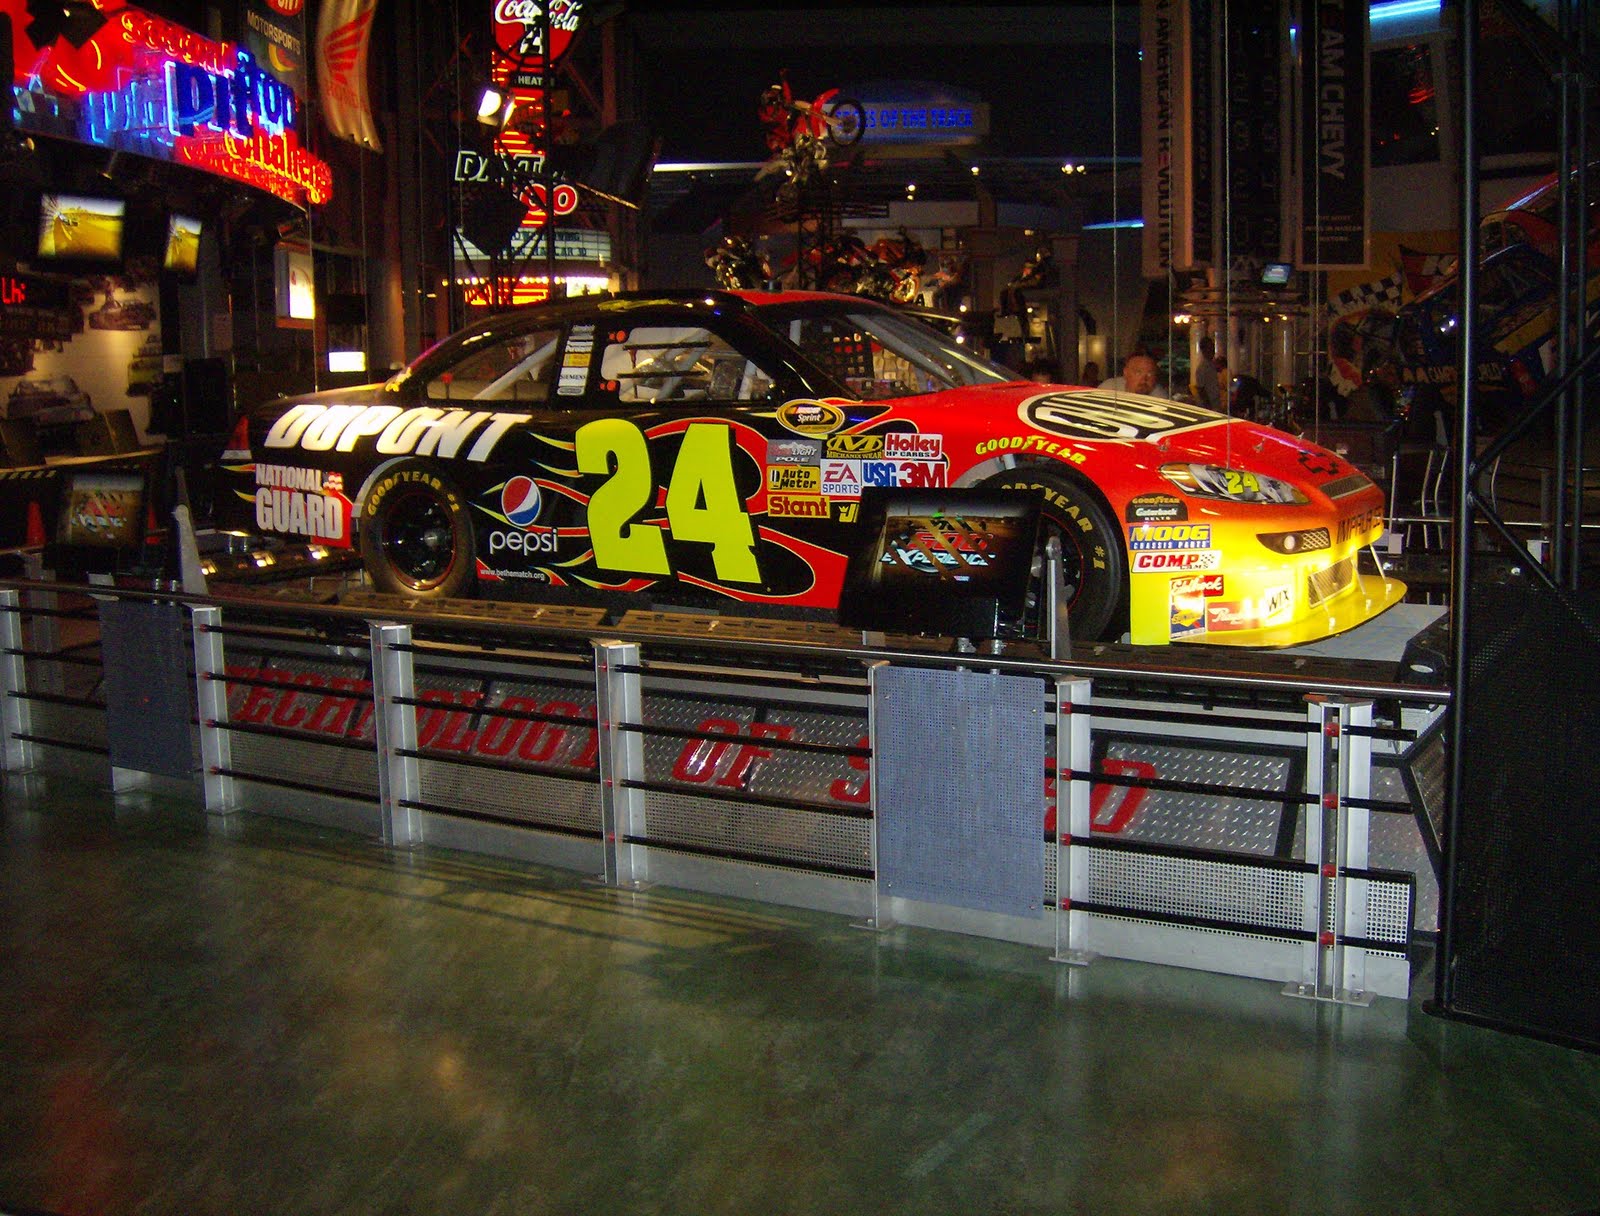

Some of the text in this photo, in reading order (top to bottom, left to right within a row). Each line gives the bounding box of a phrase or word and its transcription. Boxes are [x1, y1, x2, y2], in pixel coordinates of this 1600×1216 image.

[797, 413, 821, 424] Sprint
[887, 434, 940, 457] Holley
[976, 435, 1087, 465] GOODYEAR
[255, 463, 323, 491] NATIONAL
[780, 478, 817, 489] Meter
[782, 469, 811, 479] Auto
[824, 463, 858, 483] EA
[900, 462, 945, 488] 3M
[1225, 471, 1259, 494] 24
[367, 470, 443, 516] GOODYEAR
[822, 484, 859, 494] SPORTS
[576, 418, 762, 583] 24
[770, 497, 827, 516] Stant
[1132, 496, 1181, 505] GOODYEAR
[255, 487, 344, 540] GUARD
[489, 528, 558, 556] pepsi
[1131, 526, 1209, 541] MOOG
[1133, 541, 1173, 549] CHASSIS
[1138, 554, 1200, 568] COMP
[672, 718, 793, 789] OF
